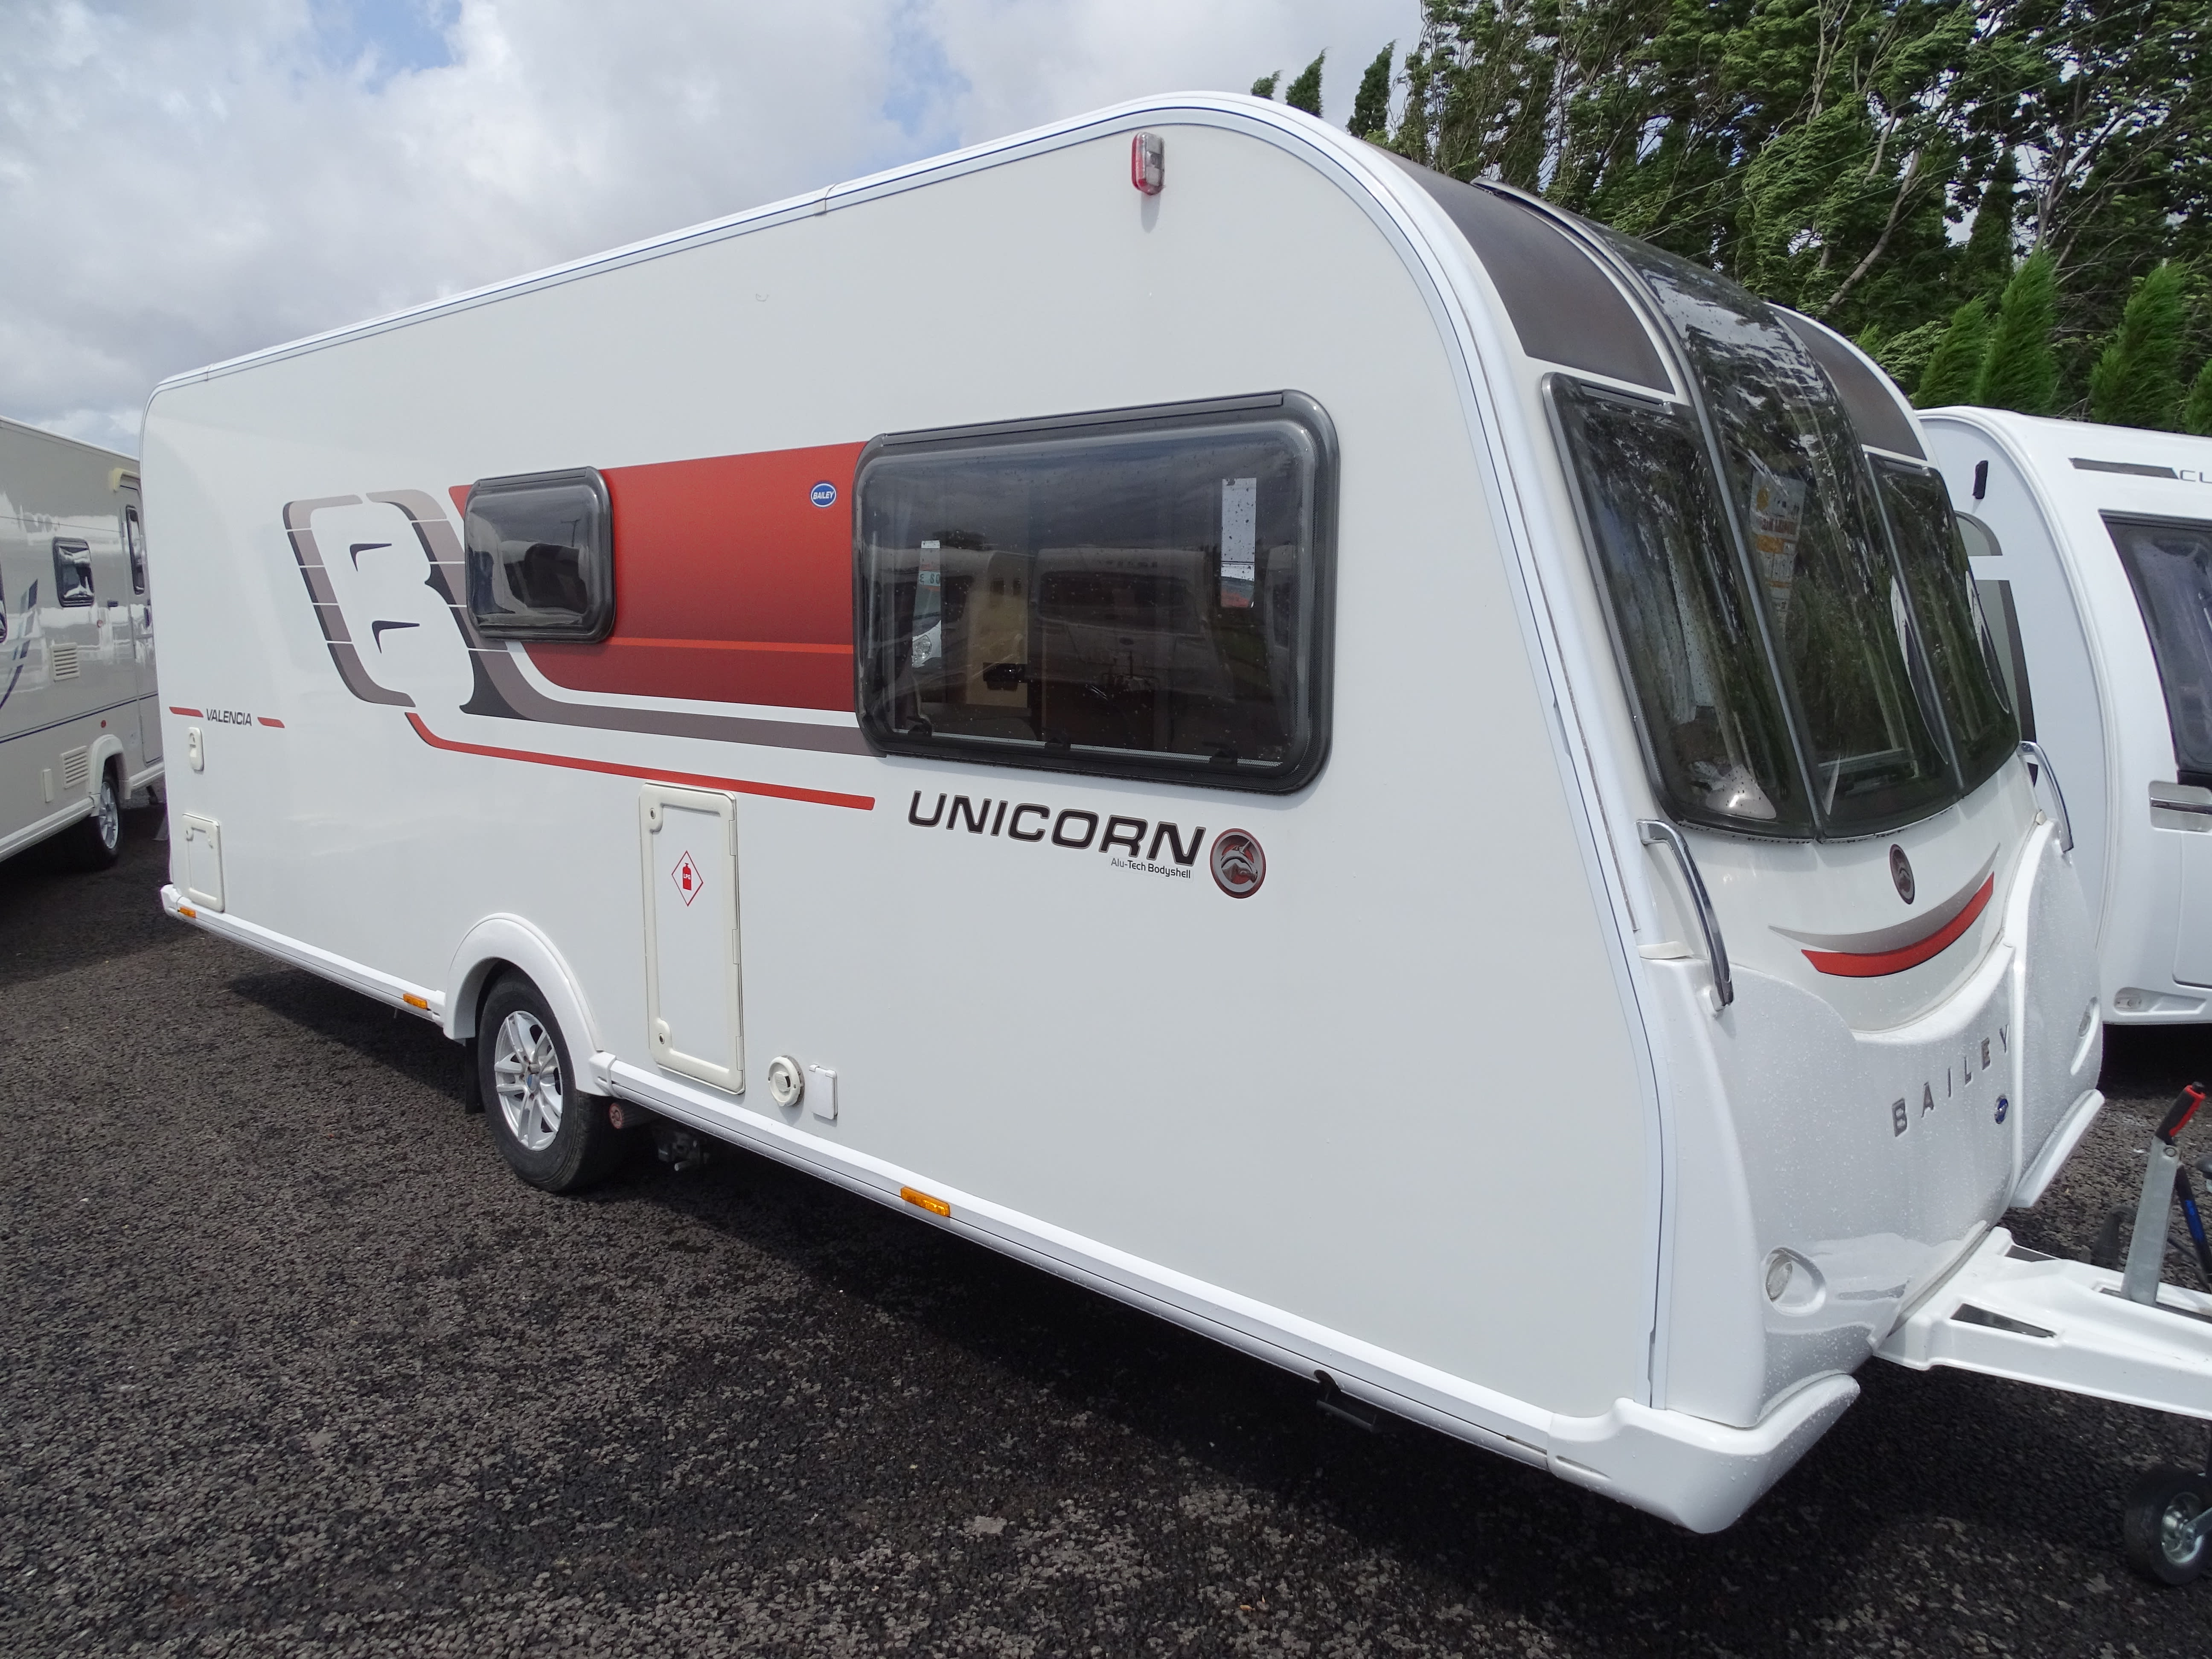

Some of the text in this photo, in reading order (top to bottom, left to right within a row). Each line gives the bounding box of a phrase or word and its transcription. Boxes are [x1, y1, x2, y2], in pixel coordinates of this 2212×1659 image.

[813, 491, 834, 500] BAILEY
[206, 708, 252, 726] VALENCIA
[908, 790, 1206, 866] UNICORN
[1111, 857, 1191, 879] Alu-Tech Bodyshell
[1892, 1024, 2008, 1137] BAILEY
